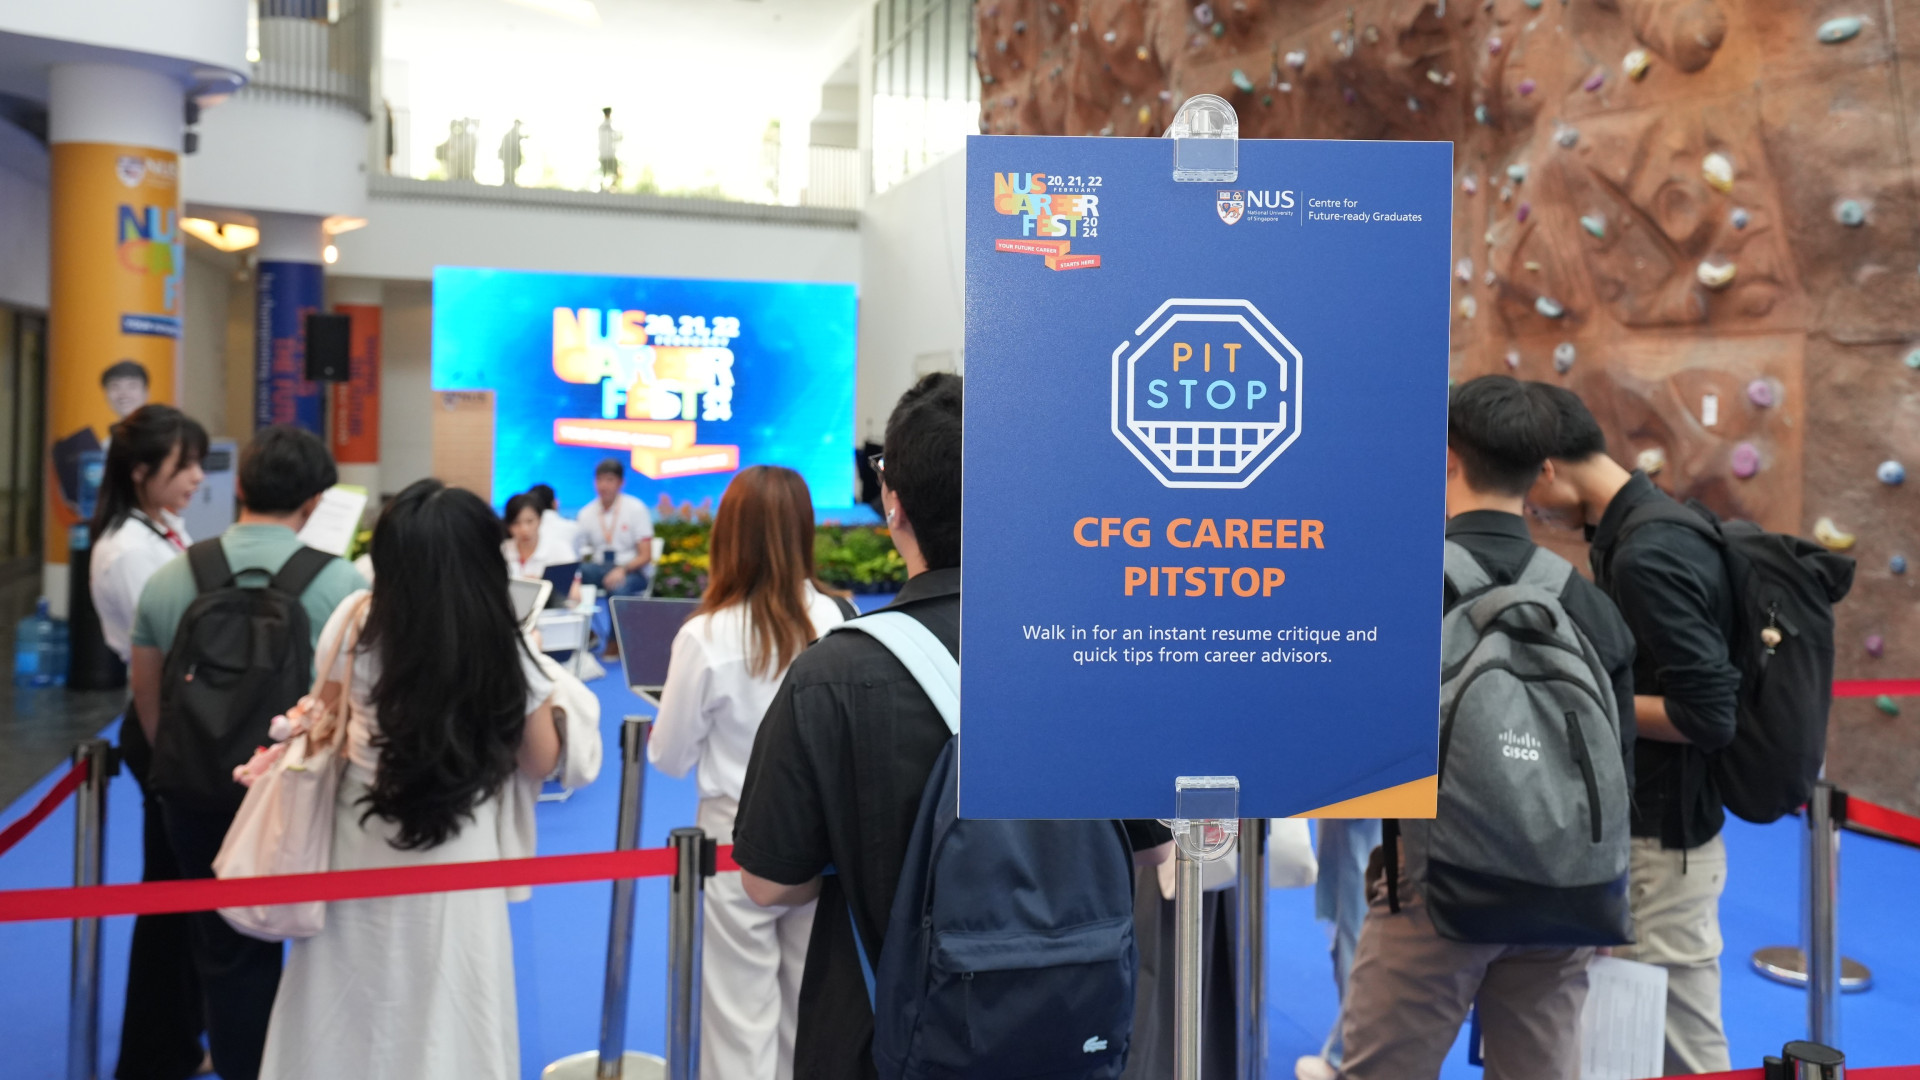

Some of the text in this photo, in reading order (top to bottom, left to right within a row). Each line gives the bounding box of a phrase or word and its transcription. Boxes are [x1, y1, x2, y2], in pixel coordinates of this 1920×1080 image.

[994, 172, 1047, 194] NUS
[1047, 175, 1103, 188] 20, 21, 22
[994, 193, 1100, 217] CAREER
[1247, 190, 1295, 208] NUS
[1308, 198, 1358, 208] Centre for
[119, 204, 176, 242] NU
[1082, 216, 1098, 227] 20
[1269, 209, 1294, 218] University
[1308, 210, 1423, 223] Future-ready Graduates
[1022, 213, 1083, 237] FEST
[1082, 227, 1098, 238] 24
[1060, 260, 1080, 268] STARTS
[553, 307, 648, 346] NUS
[1172, 342, 1242, 373] PIT
[1147, 378, 1267, 410] STOP
[1072, 516, 1325, 549] CFG CAREER
[1124, 566, 1286, 597] PITSTOP
[1022, 624, 1377, 645] Walk in for an instant resume critique and
[1072, 646, 1332, 666] quick tips from career advisors.
